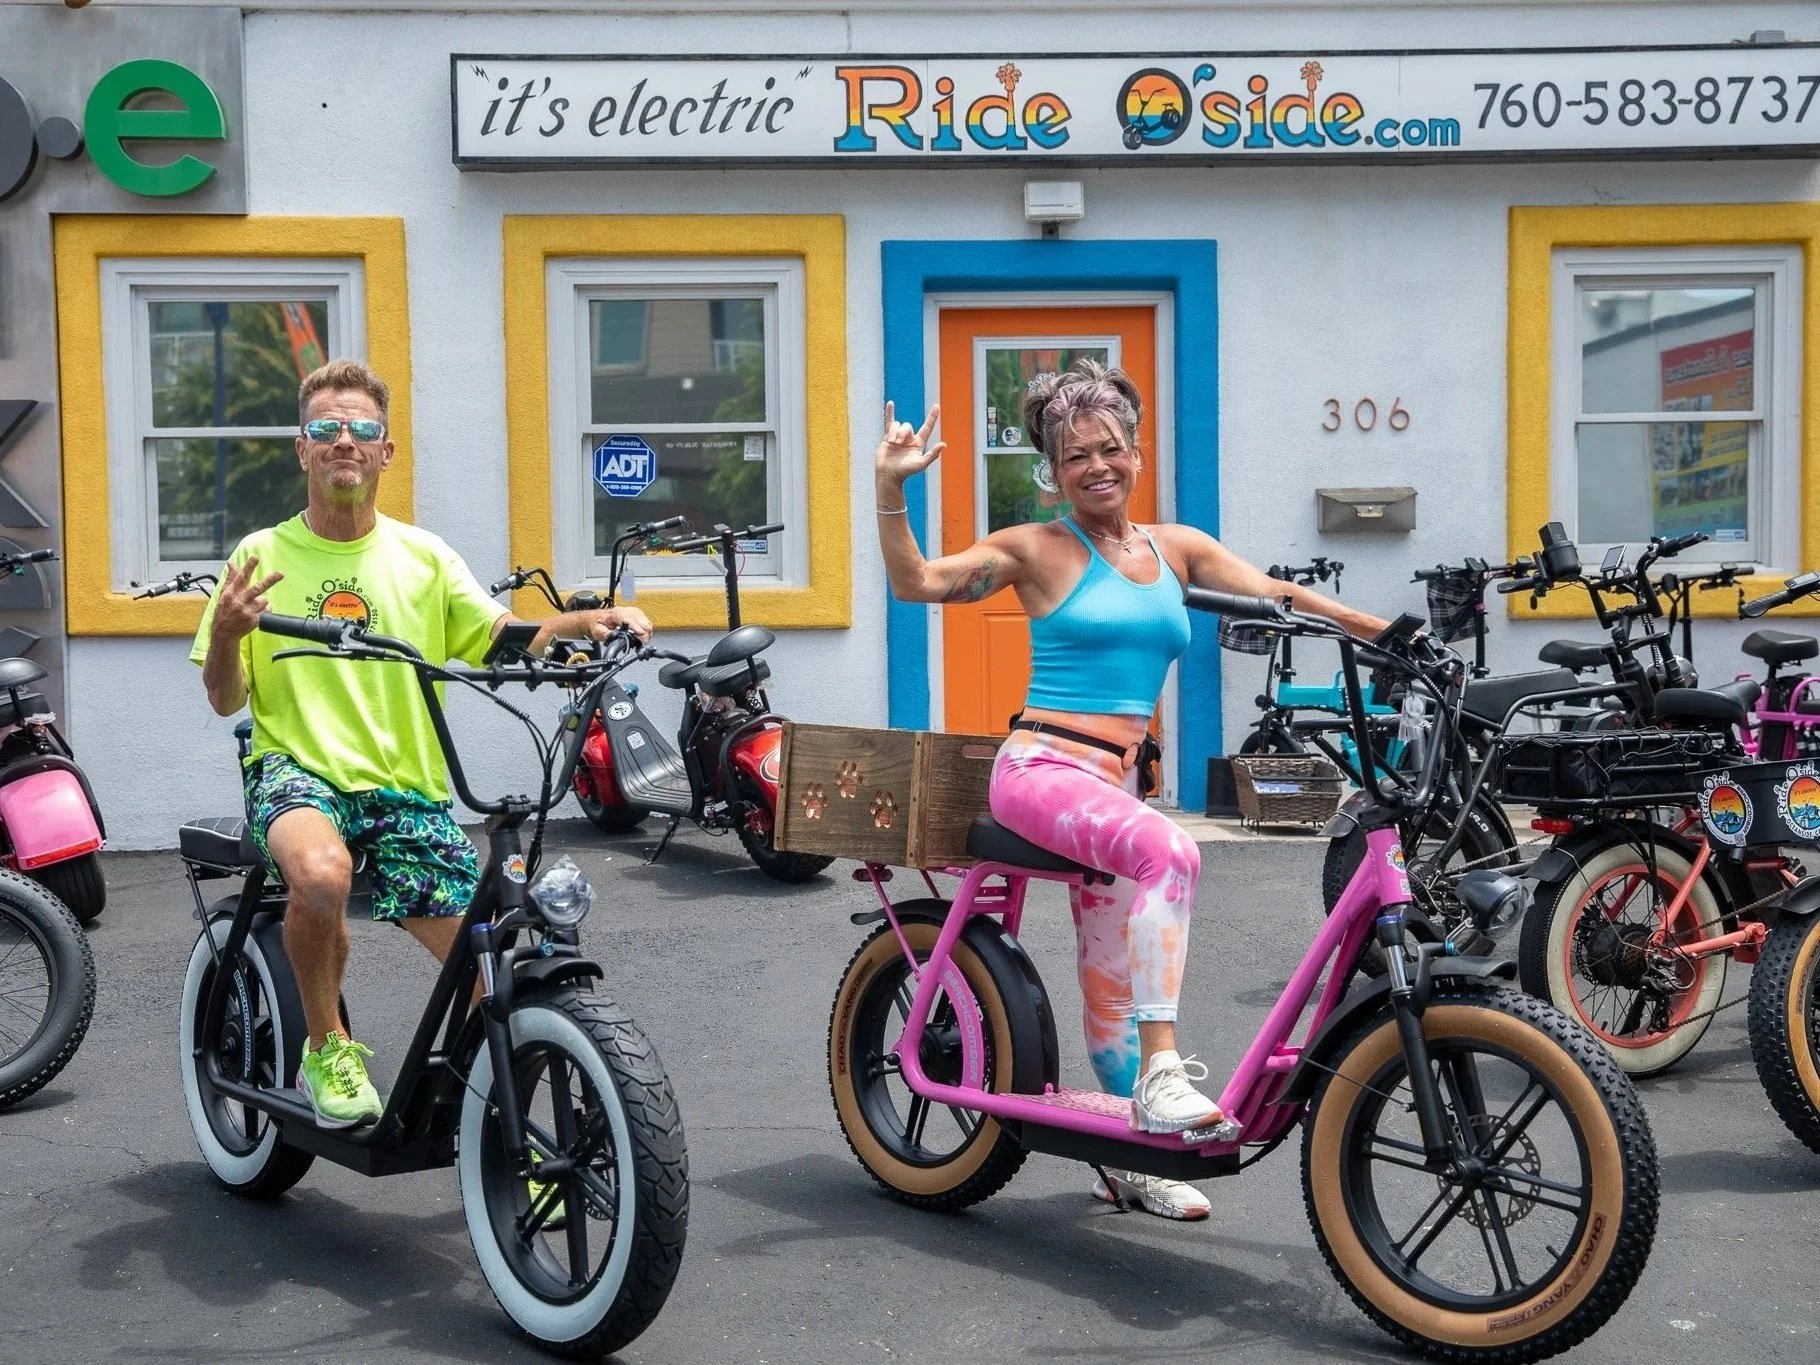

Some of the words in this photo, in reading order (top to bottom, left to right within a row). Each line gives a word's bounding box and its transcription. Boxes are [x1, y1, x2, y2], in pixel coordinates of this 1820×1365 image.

[833, 63, 1072, 152] Ride
[1474, 76, 1820, 129] 760-583-8737
[1322, 397, 1410, 431] 306
[602, 454, 648, 479] ADT
[1580, 1216, 1603, 1266] CHAO
[1534, 1282, 1572, 1314] YANG
